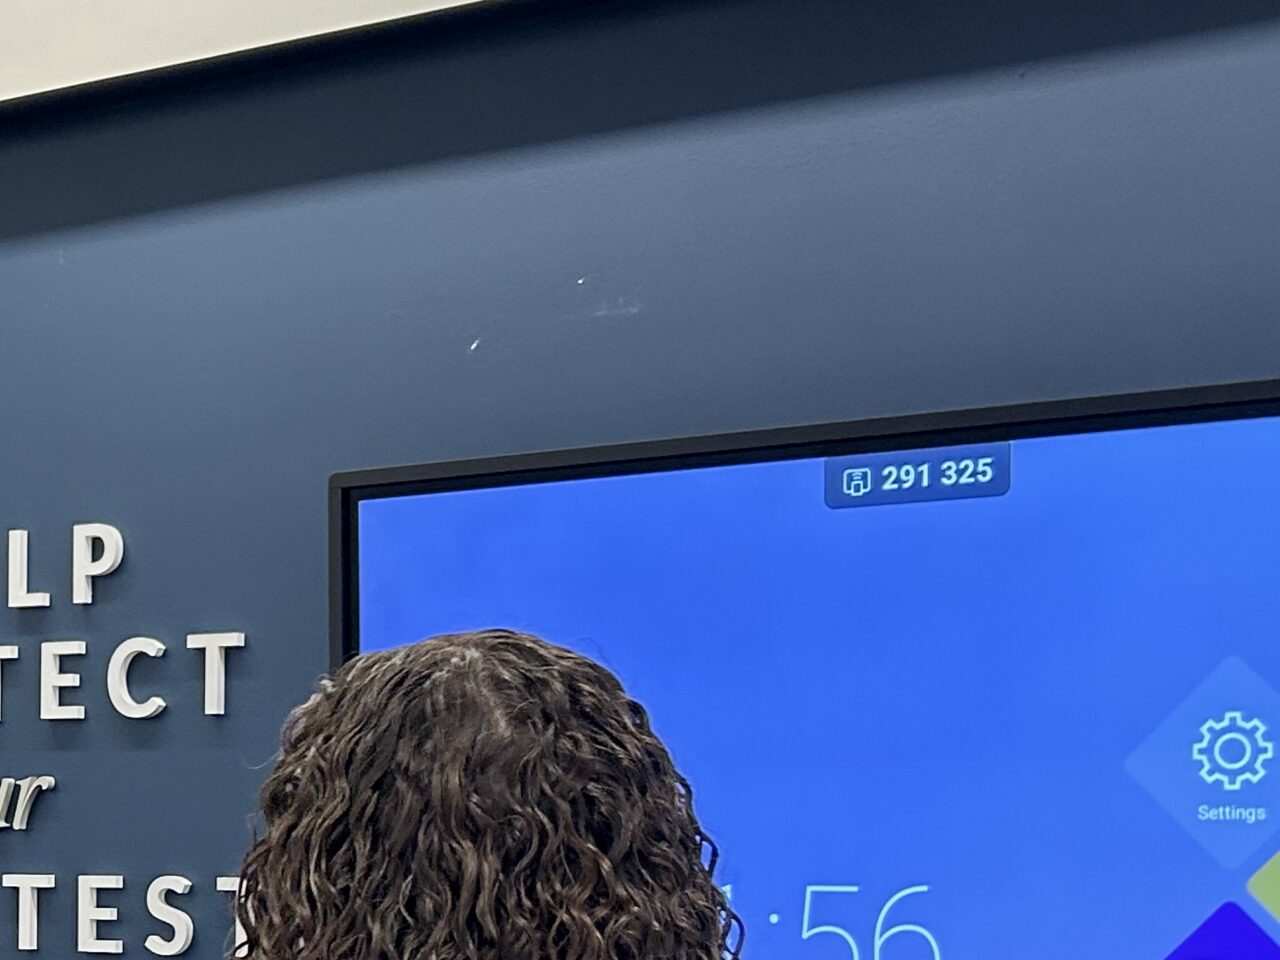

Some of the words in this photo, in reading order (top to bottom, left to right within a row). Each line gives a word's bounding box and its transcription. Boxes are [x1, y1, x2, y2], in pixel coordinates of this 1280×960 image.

[881, 463, 929, 491] 291
[940, 457, 993, 486] 325
[1198, 804, 1266, 823] Settings
